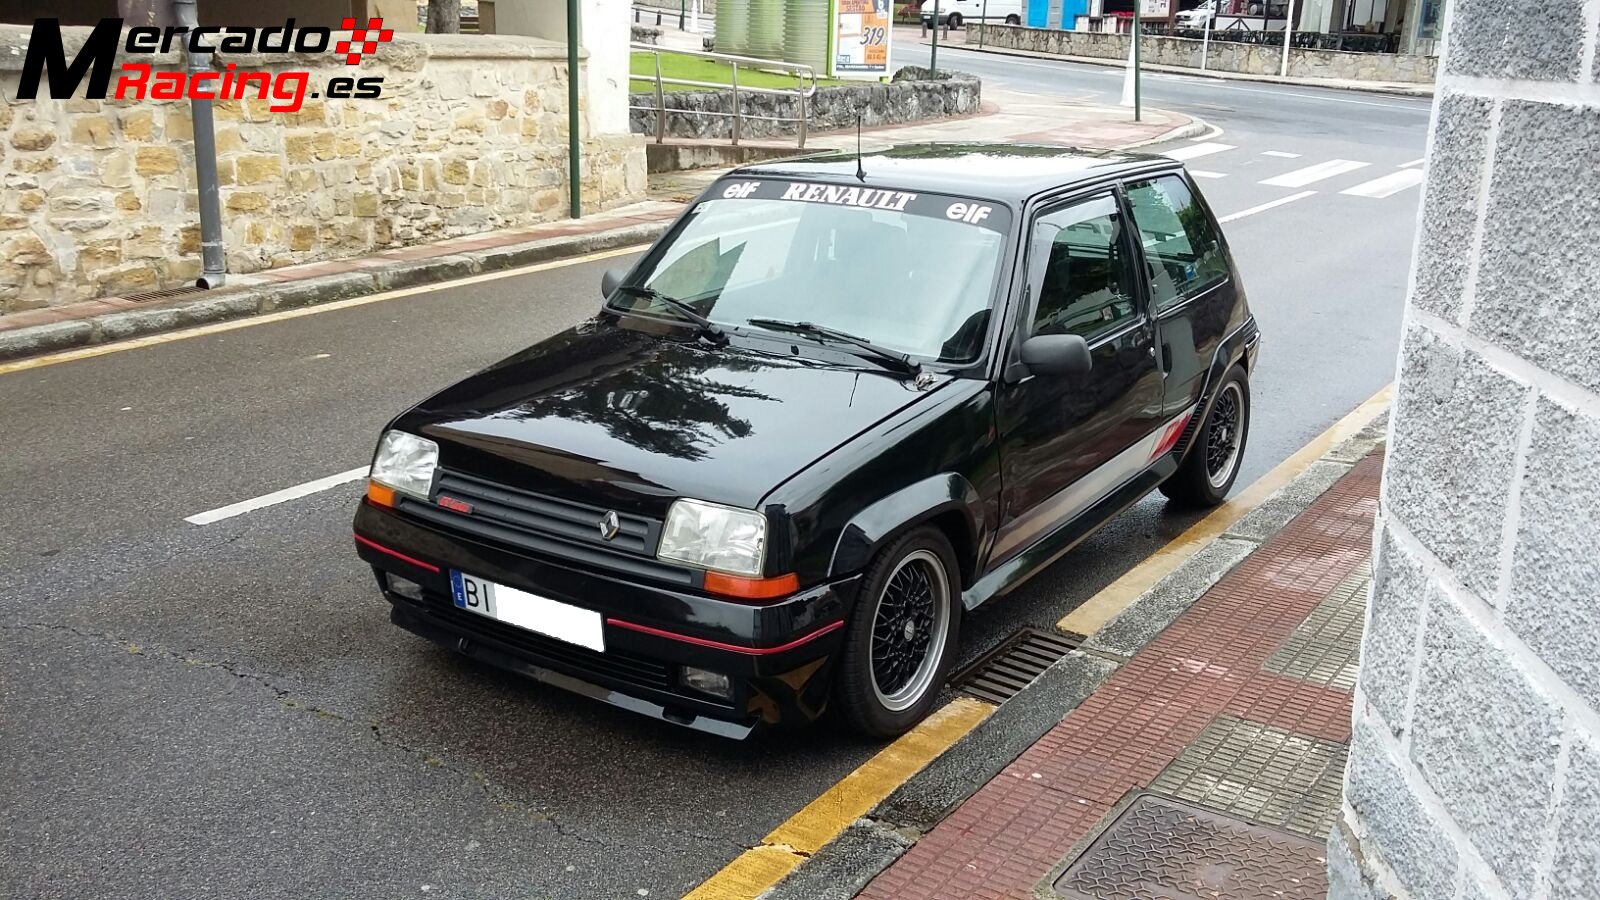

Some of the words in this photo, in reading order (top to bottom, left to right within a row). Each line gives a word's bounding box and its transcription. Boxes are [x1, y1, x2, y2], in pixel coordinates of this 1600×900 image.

[859, 26, 885, 46] 319
[722, 181, 761, 200] elf
[780, 182, 917, 212] RENAULT
[945, 201, 993, 226] elf
